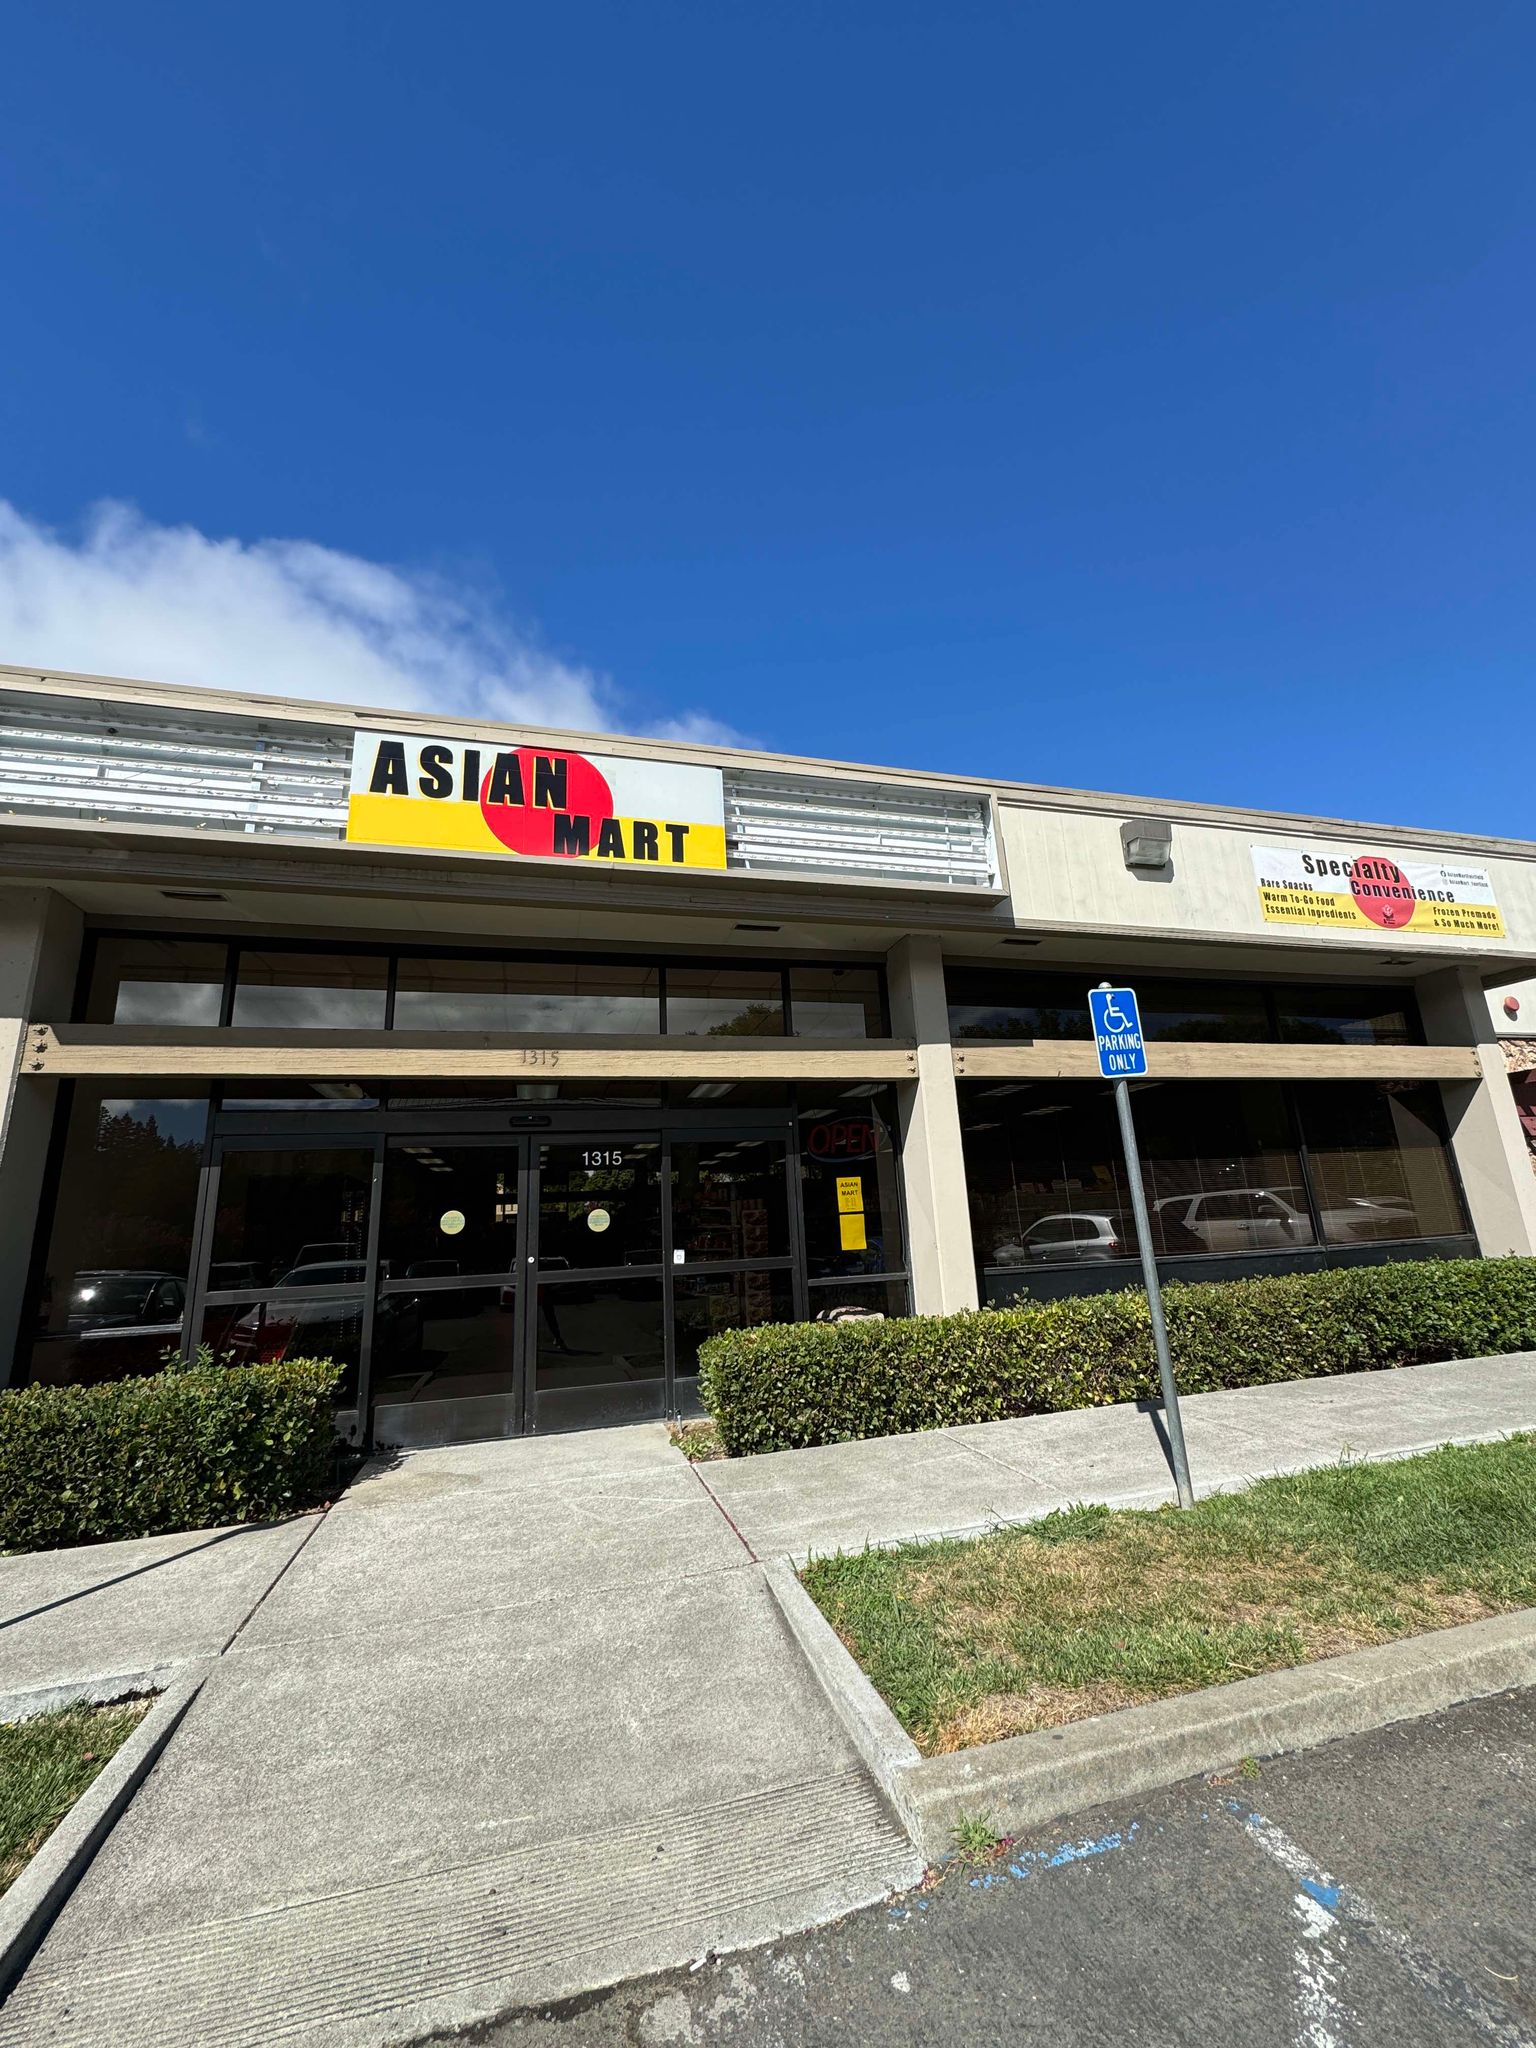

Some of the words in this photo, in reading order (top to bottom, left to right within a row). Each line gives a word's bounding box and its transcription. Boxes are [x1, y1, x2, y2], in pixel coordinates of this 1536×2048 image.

[370, 740, 568, 810] ASIAN
[554, 814, 689, 863] MART
[1301, 854, 1400, 883] Specialty
[1260, 878, 1280, 888] Rare
[1283, 880, 1313, 891] Snacks
[1350, 880, 1455, 903] Convenience
[1263, 892, 1288, 902] Warm
[1290, 894, 1314, 905] To-Go
[1316, 896, 1335, 906] Food
[1265, 904, 1306, 916] Essential
[1308, 908, 1356, 920] Ingredients
[1433, 907, 1460, 917] Frozen
[1462, 909, 1497, 919] Premade
[1441, 919, 1452, 927] So
[1453, 919, 1475, 929] Much
[1477, 921, 1500, 931] More!
[1098, 1032, 1141, 1052] PARKING
[522, 1049, 559, 1067] 1315
[1108, 1053, 1136, 1071] ONLY
[808, 1123, 879, 1153] OPEN
[582, 1151, 622, 1166] 1315
